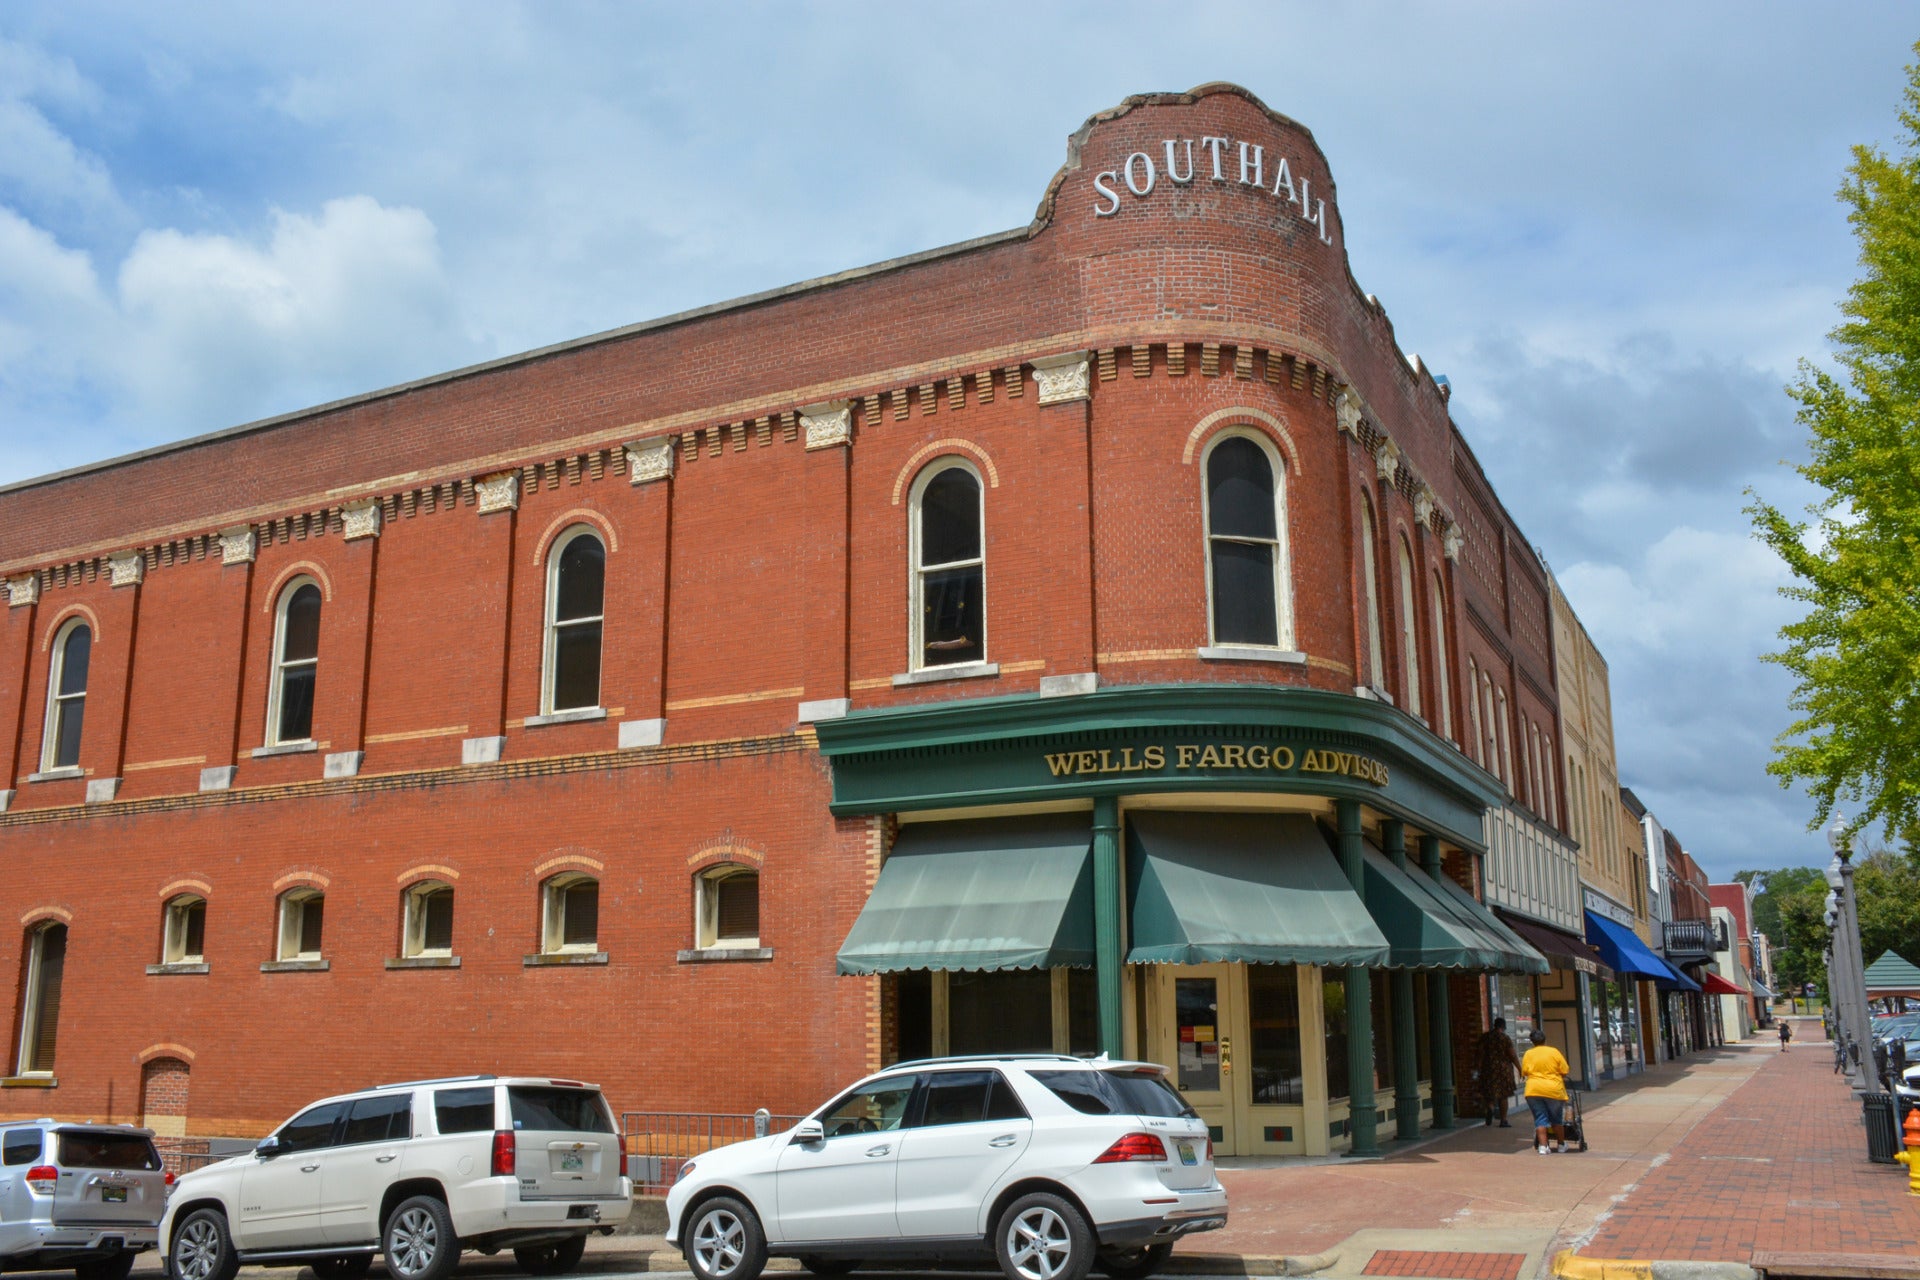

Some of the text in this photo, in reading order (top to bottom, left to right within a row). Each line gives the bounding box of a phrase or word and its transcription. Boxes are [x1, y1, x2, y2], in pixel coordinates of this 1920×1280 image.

[1093, 136, 1332, 246] SOUTHALL
[1044, 744, 1390, 787] WELLS FARGO ADVISORS
